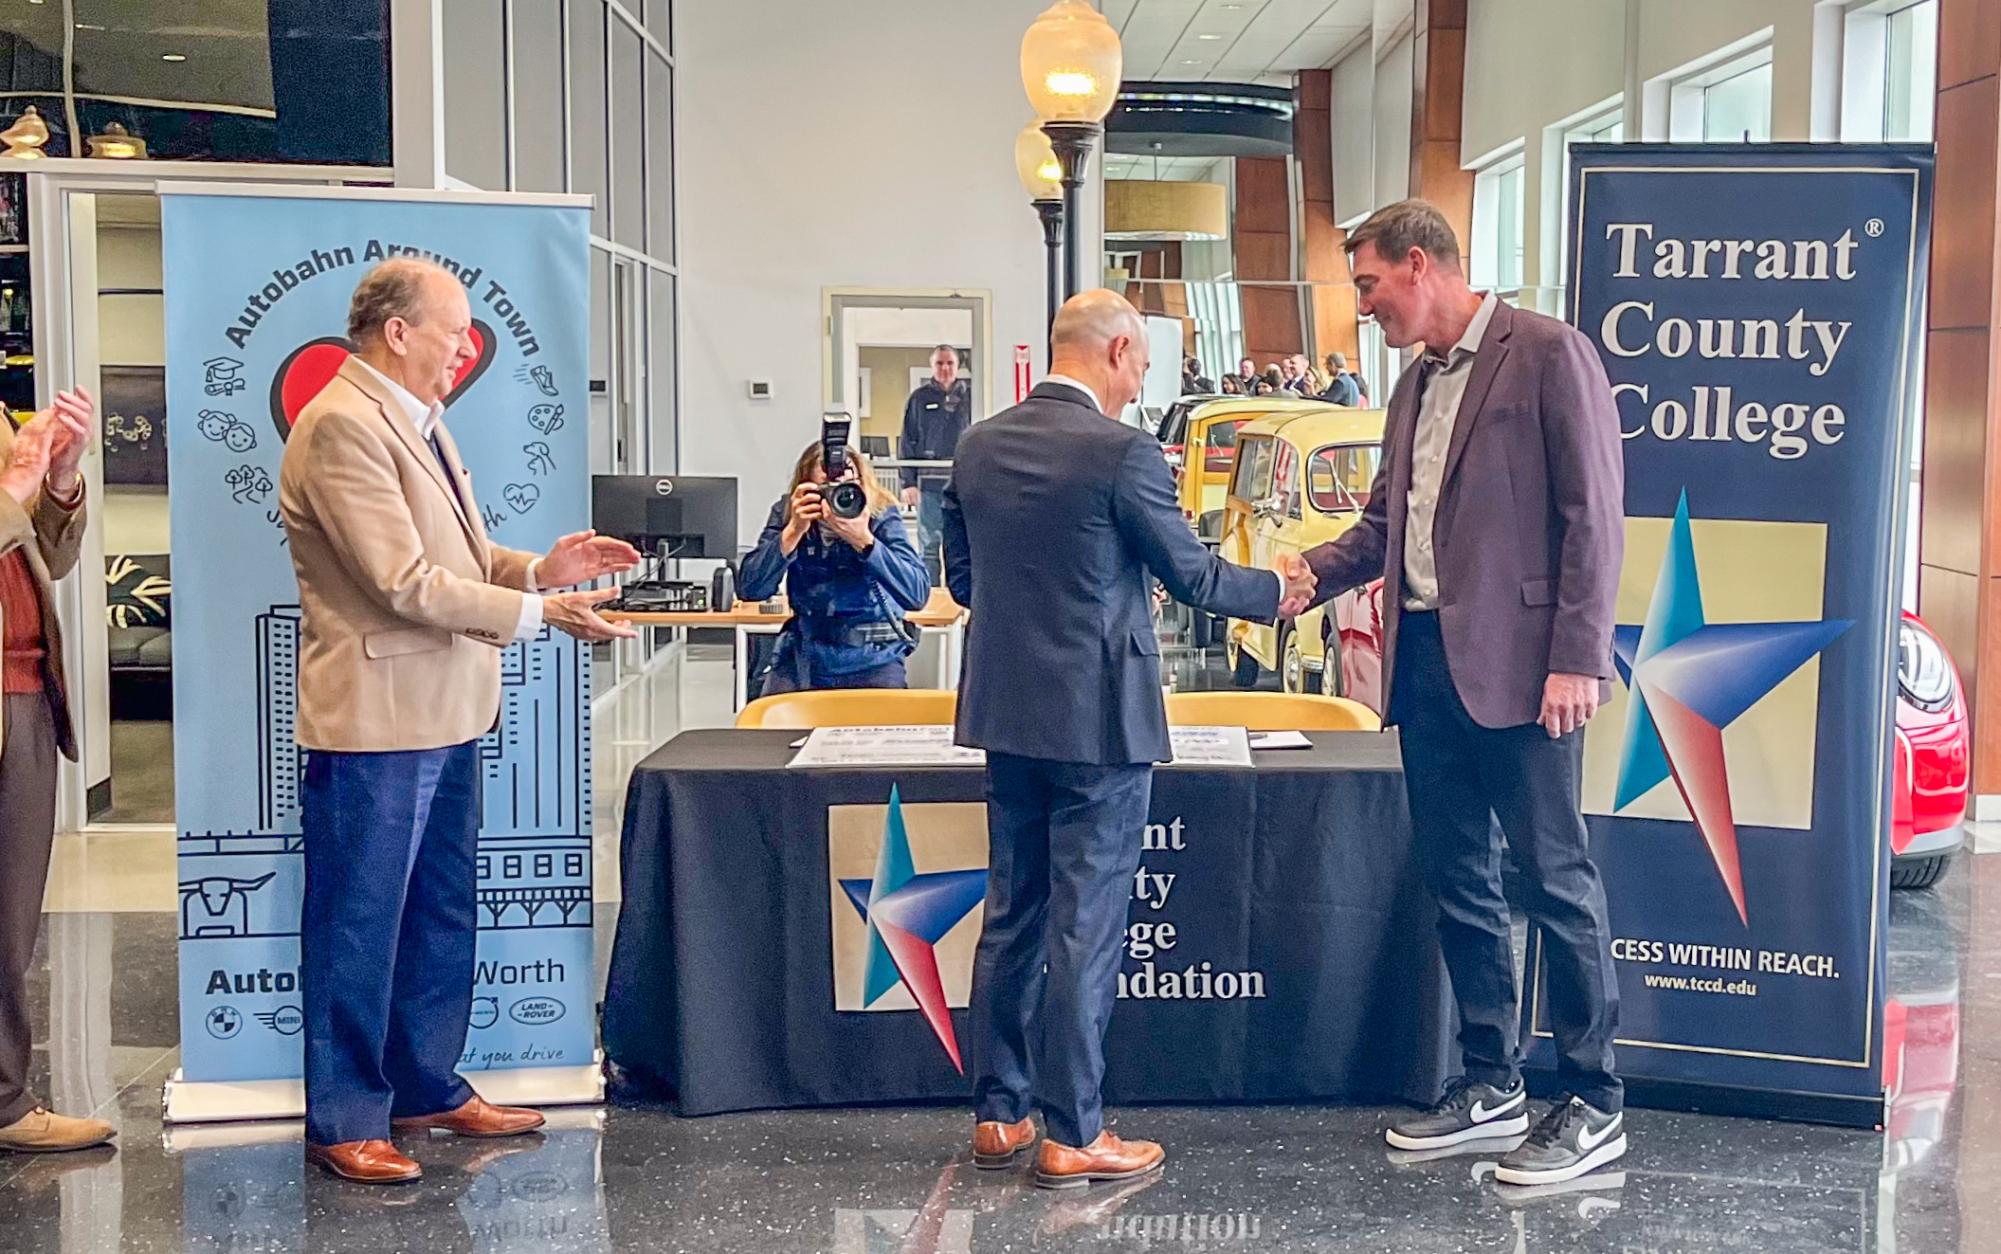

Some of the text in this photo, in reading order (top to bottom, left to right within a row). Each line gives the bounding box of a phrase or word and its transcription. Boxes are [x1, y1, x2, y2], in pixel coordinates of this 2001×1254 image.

[1606, 222, 1859, 281] Tarrant
[225, 246, 355, 350] Autobahn
[483, 280, 540, 357] Town
[1601, 300, 1852, 377] County
[1611, 383, 1846, 460] College
[474, 958, 564, 985] Worth
[1668, 943, 1751, 971] WITHIN
[1758, 951, 1840, 978] REACH.
[1644, 974, 1757, 996] www.tccd.edu
[482, 1052, 514, 1070] you
[520, 1043, 565, 1060] drive
